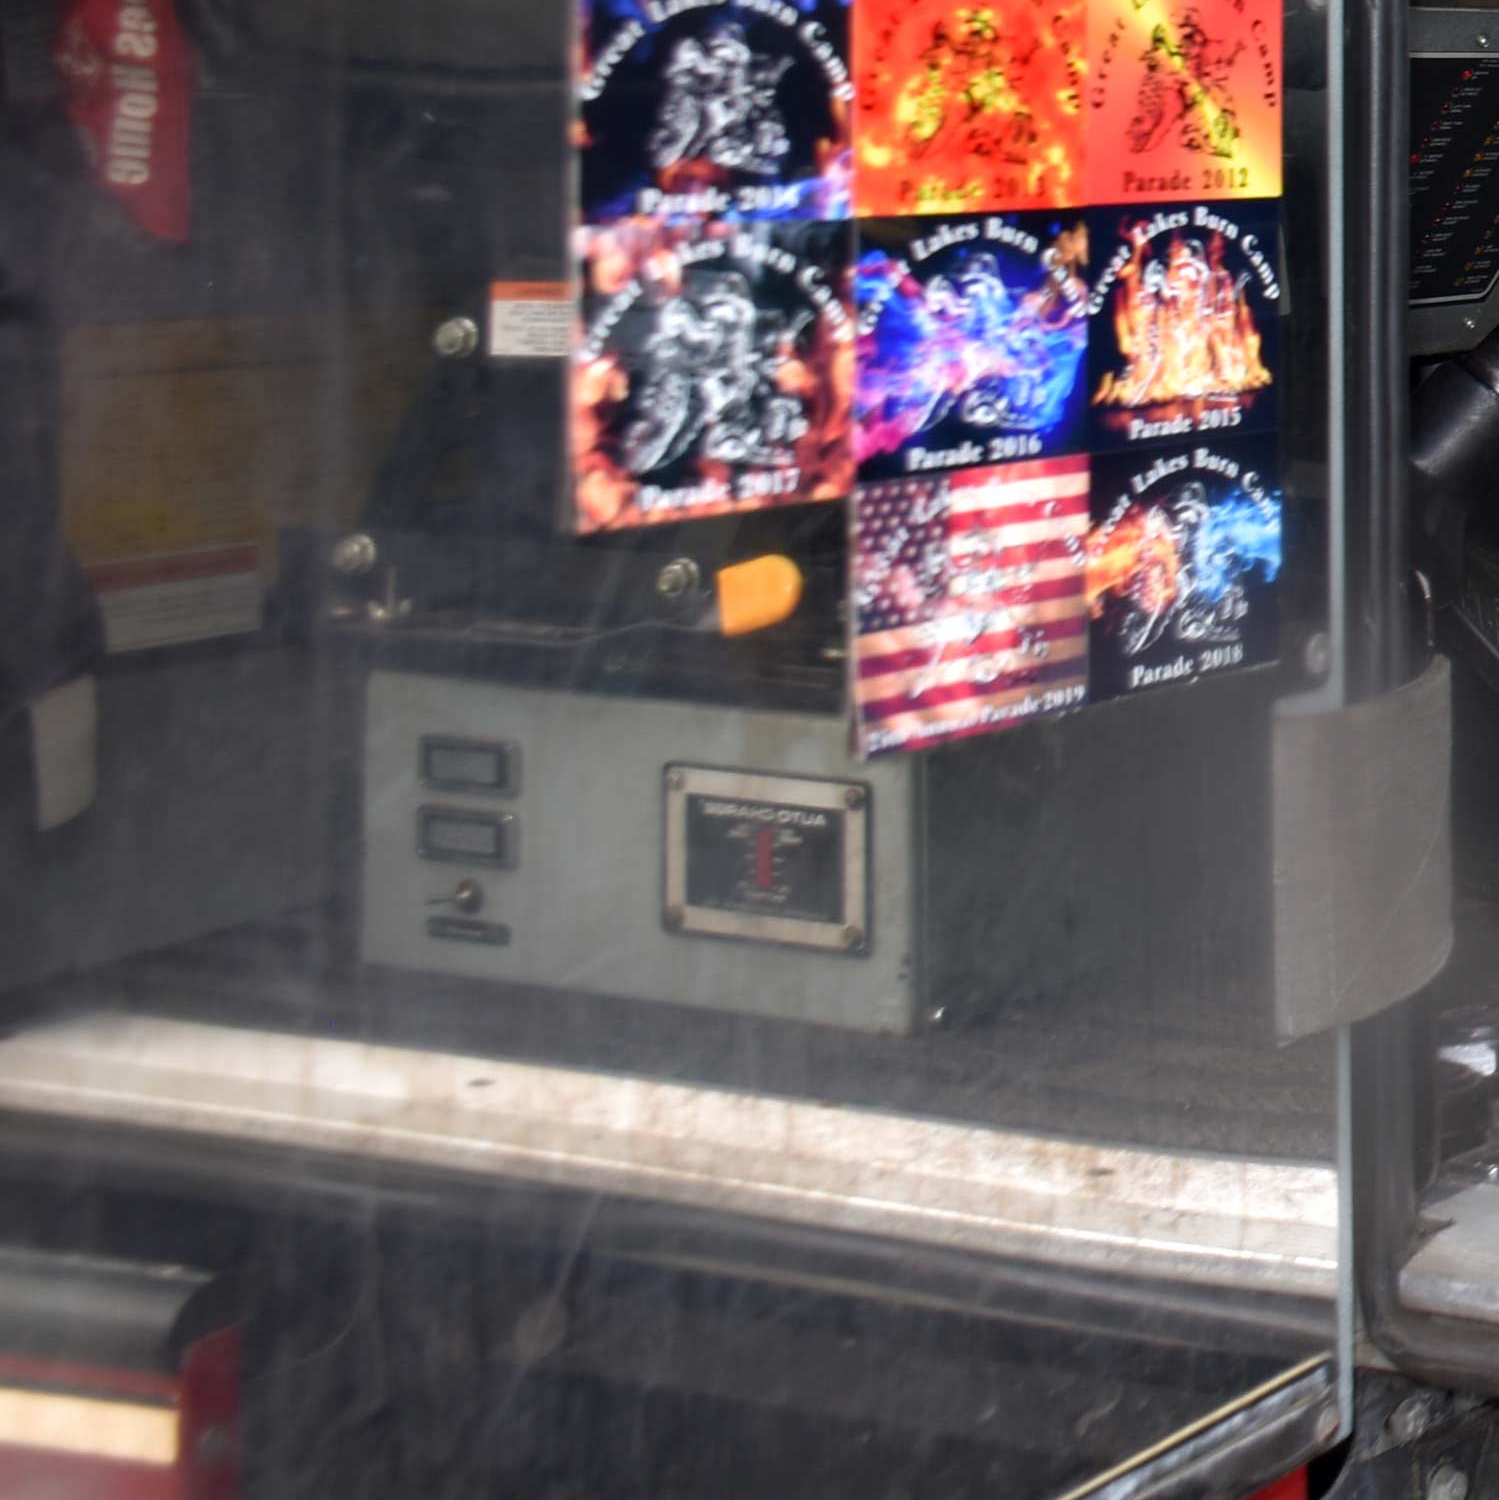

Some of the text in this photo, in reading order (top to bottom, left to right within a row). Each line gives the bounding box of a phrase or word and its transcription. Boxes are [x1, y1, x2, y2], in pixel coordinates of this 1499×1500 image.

[801, 21, 855, 101] Camp
[1252, 19, 1276, 109] Camp
[637, 186, 731, 214] Parade
[1123, 168, 1248, 192] Parade 2012
[911, 223, 979, 261] Lakes
[985, 216, 1039, 254] Burn
[1132, 211, 1189, 246] Lakes
[1194, 206, 1239, 240] Burn
[1241, 234, 1281, 300] Camp
[800, 266, 855, 342] Camp
[1129, 405, 1242, 440] Parade 2015
[907, 434, 1043, 471] Parade 2016
[1131, 447, 1240, 494] Lakes Burn
[737, 467, 800, 496] 2017
[1130, 644, 1243, 688] Parade 2018
[1042, 682, 1085, 711] 2019
